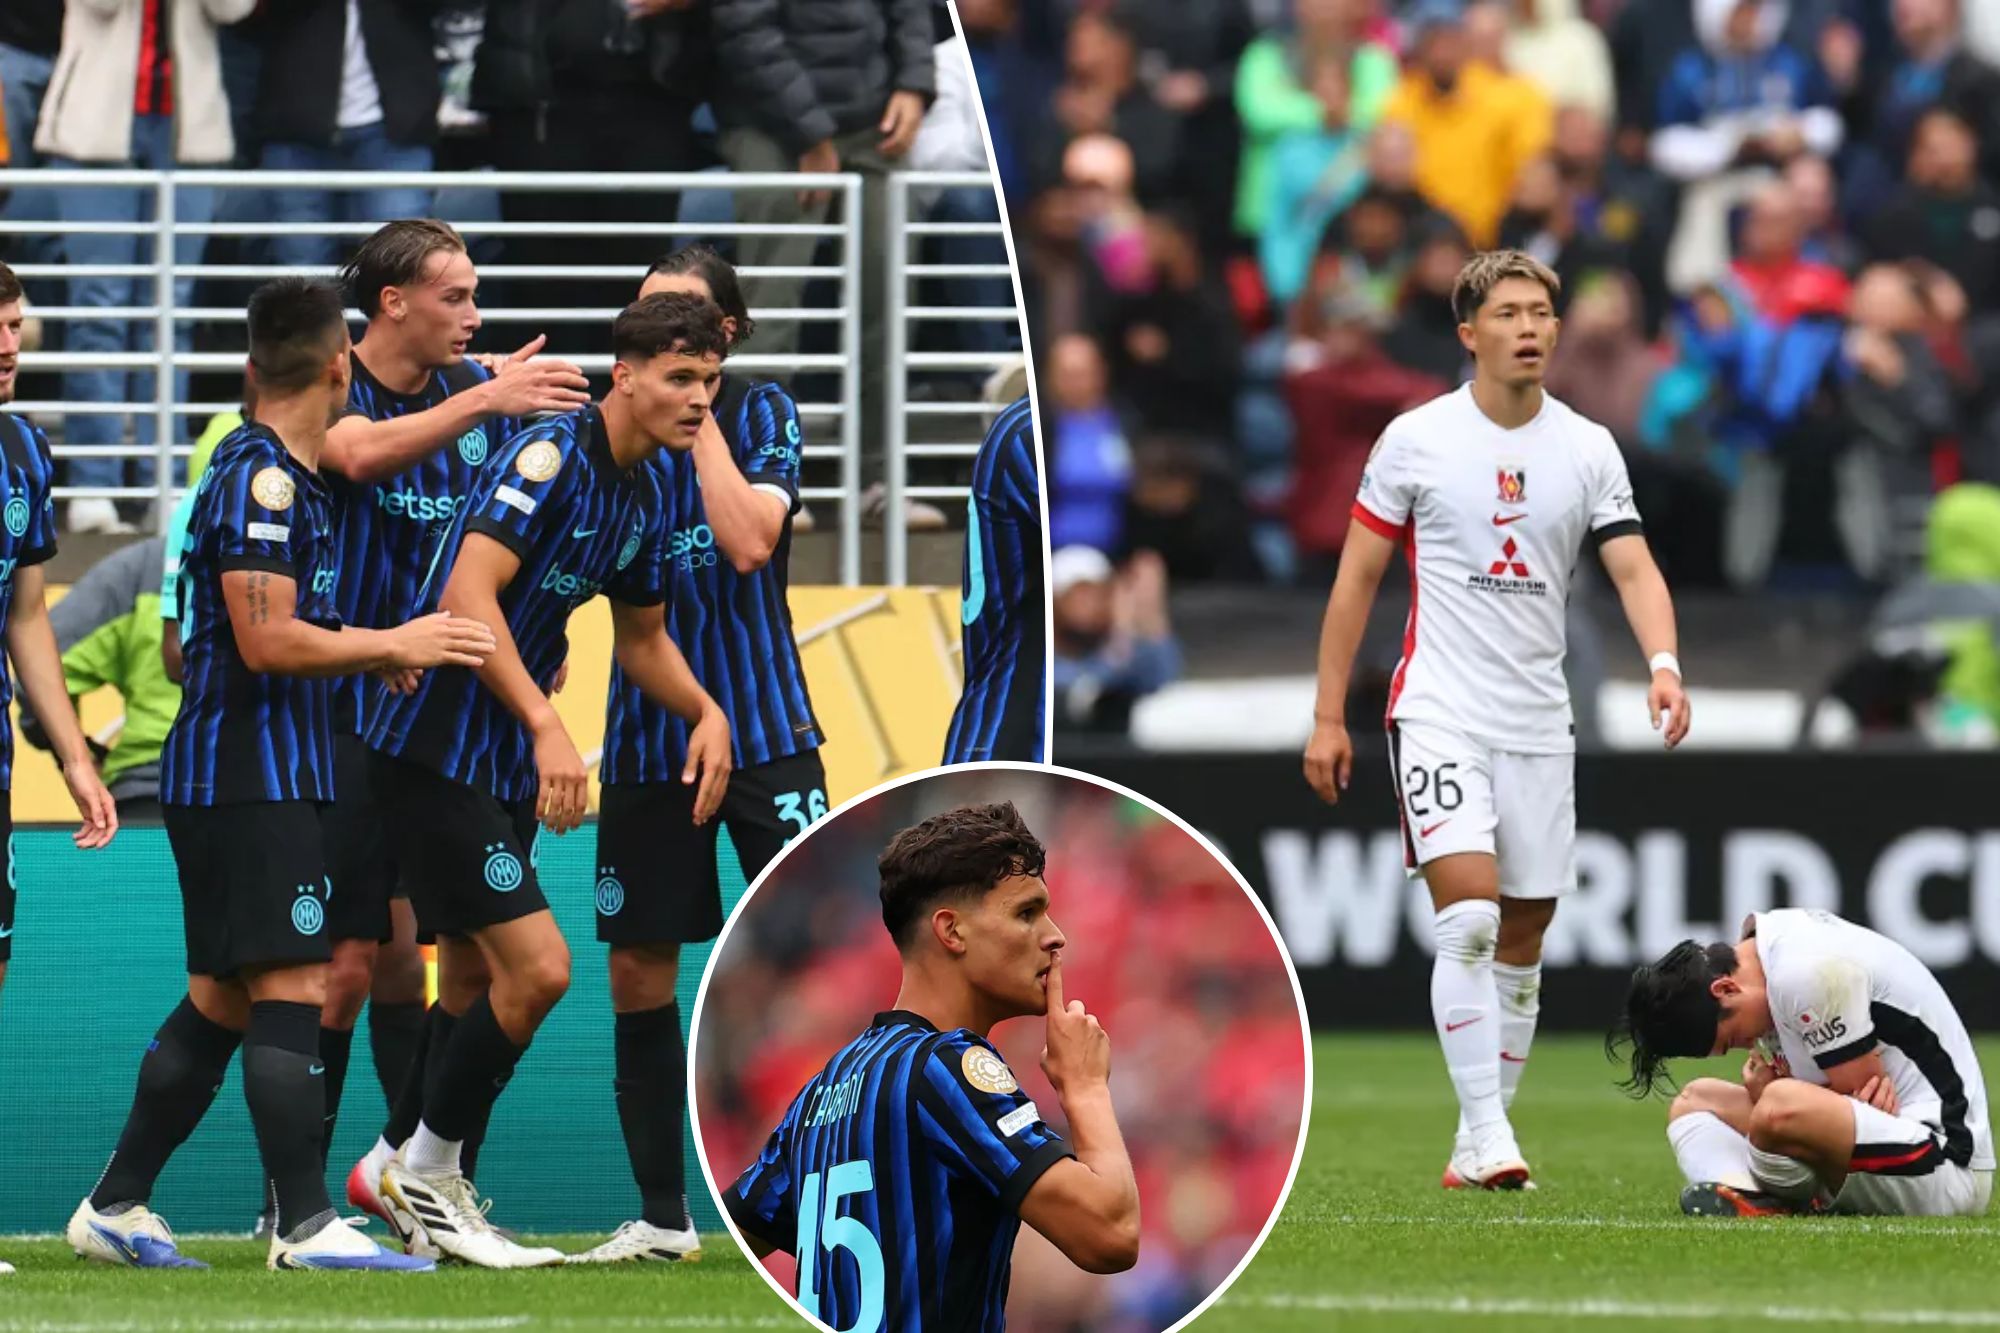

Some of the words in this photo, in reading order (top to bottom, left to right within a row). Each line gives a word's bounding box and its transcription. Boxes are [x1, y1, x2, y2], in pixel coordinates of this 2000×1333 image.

[1468, 575, 1547, 590] MITSUBISHI
[1406, 763, 1463, 816] 26
[774, 789, 828, 848] 36
[1261, 827, 1840, 968] WRLD
